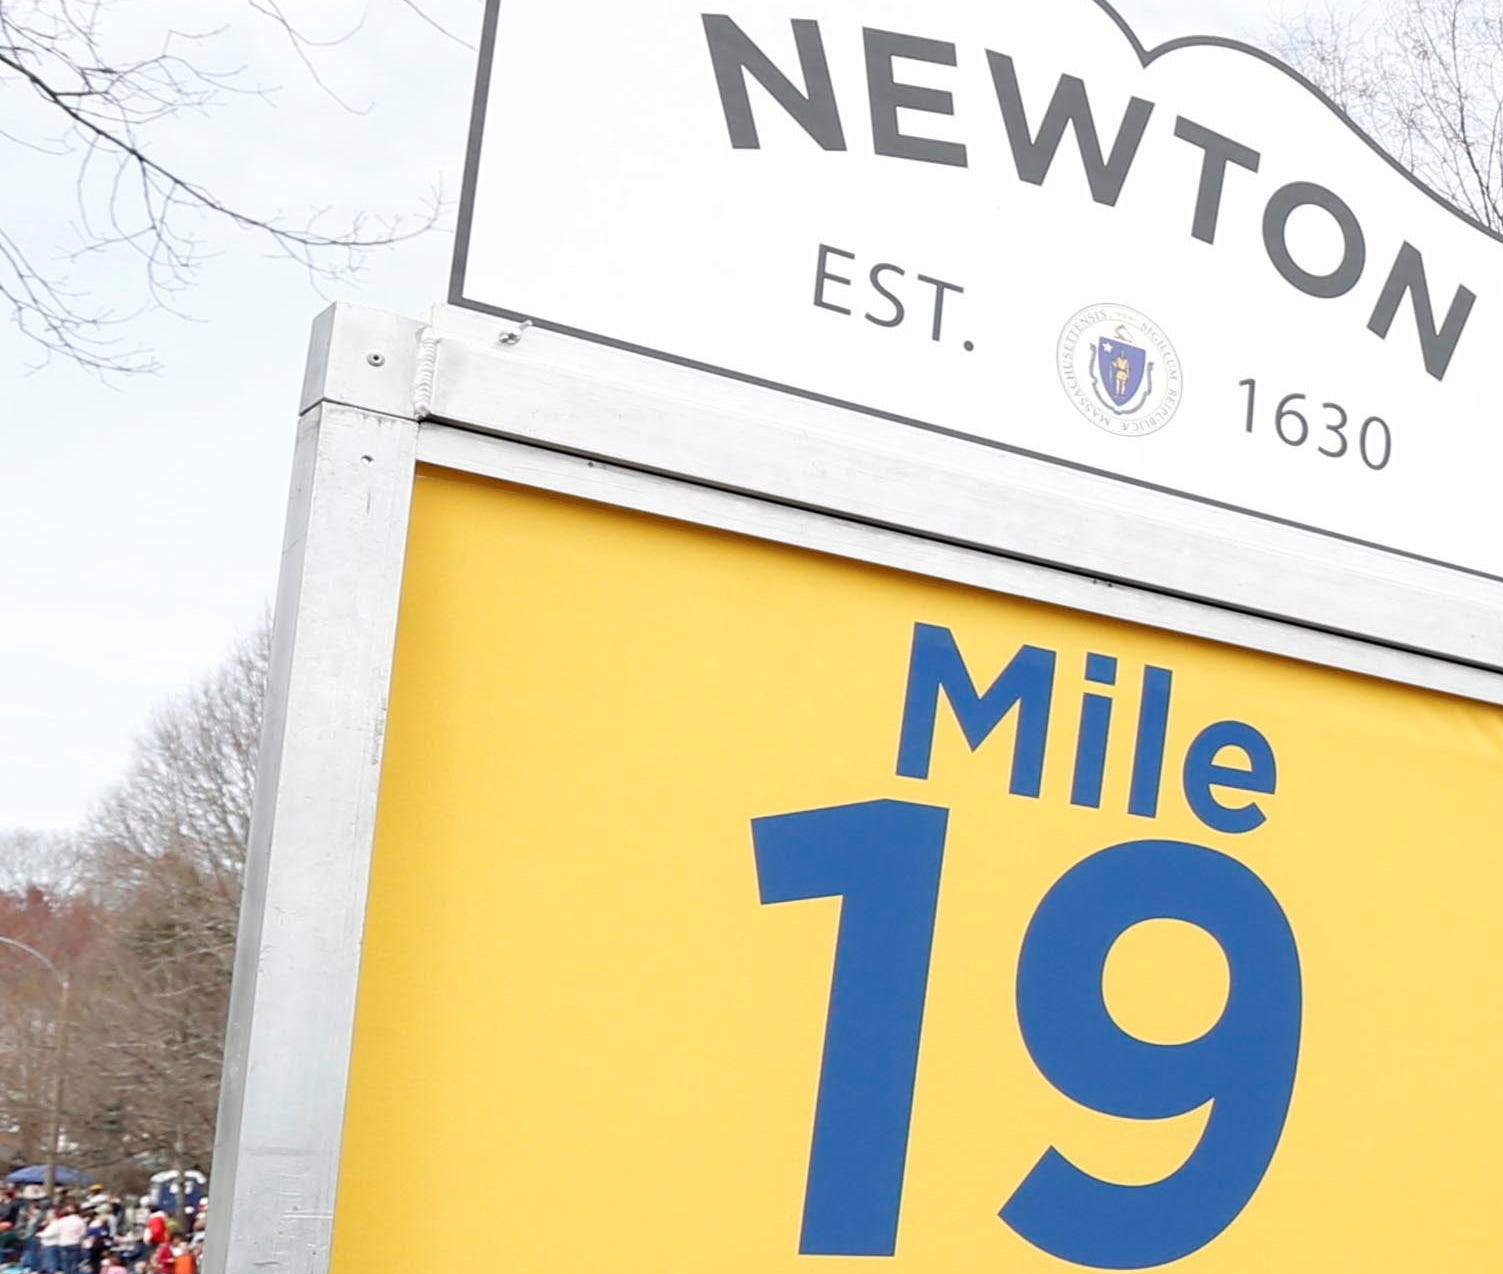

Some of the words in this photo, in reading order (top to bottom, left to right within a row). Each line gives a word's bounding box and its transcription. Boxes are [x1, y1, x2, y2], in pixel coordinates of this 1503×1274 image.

[701, 13, 1477, 382] NEWTON
[813, 243, 975, 352] EST.
[1238, 378, 1392, 471] 1630
[895, 621, 1277, 834] Mile
[751, 798, 1302, 1270] 19
